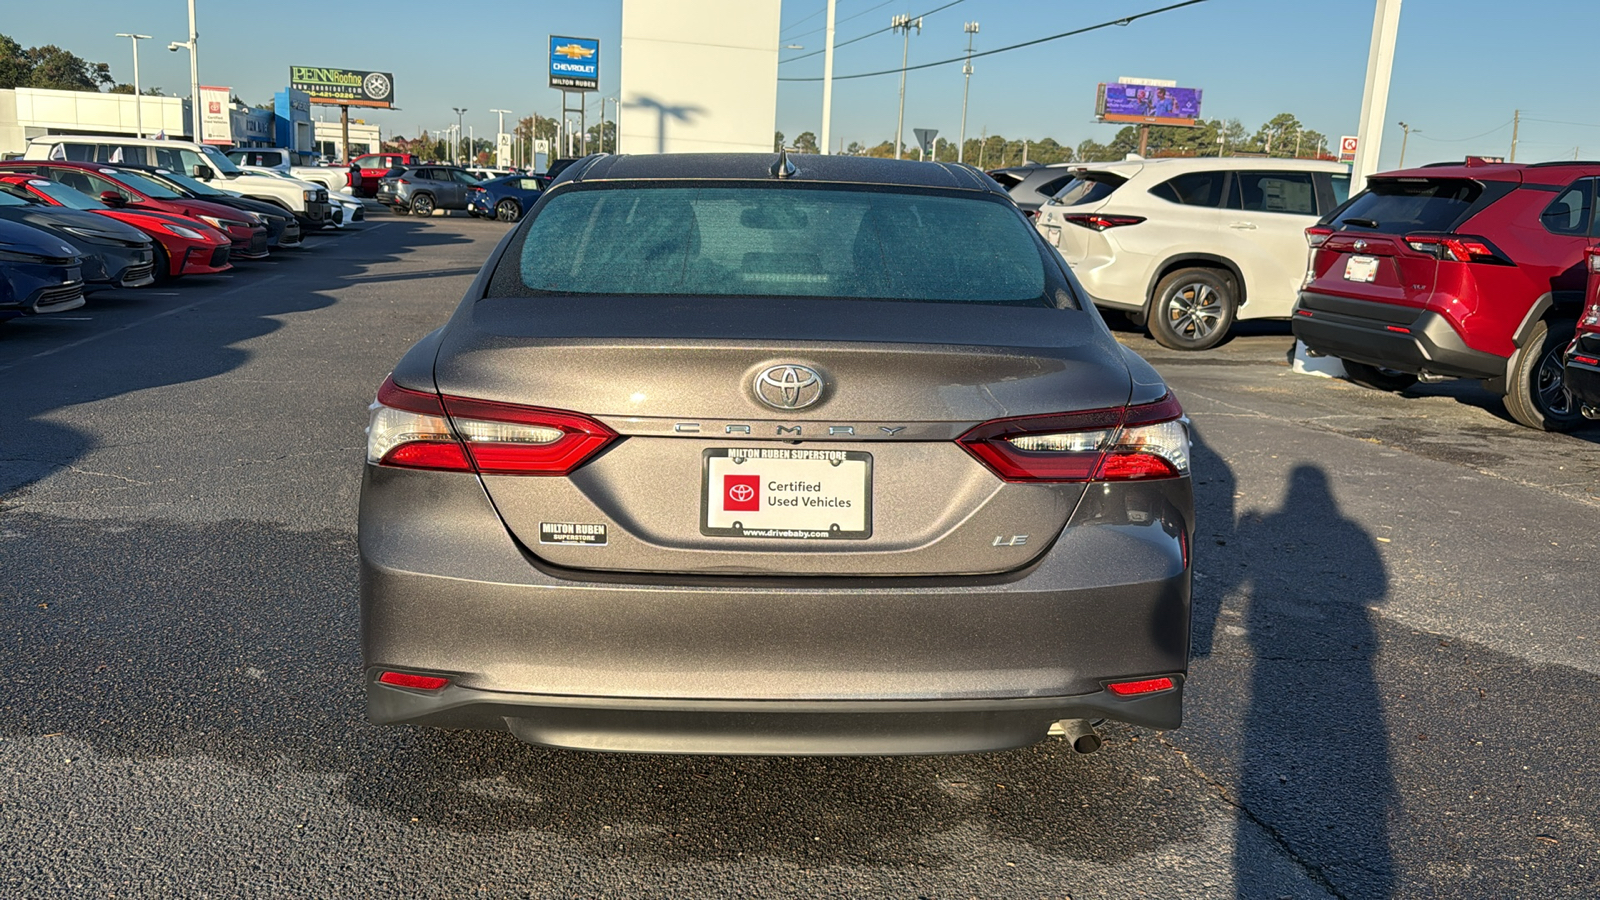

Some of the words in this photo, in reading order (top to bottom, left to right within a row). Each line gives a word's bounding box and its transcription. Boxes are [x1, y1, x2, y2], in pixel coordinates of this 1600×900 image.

[553, 63, 595, 73] CHEVROLET
[334, 71, 362, 87] Roofing
[552, 78, 574, 86] MILTON
[575, 80, 596, 88] RUBEN
[293, 83, 362, 94] www.pennroof.com
[674, 422, 908, 436] CAMRY
[728, 449, 759, 459] MILTON
[761, 449, 790, 459] RUBEN
[791, 450, 847, 461] SUPERSTORE
[768, 481, 821, 492] Certified
[768, 496, 798, 507] Used
[802, 497, 851, 508] Vehicles
[542, 523, 574, 533] MILTON
[575, 525, 605, 535] RUBEN
[743, 529, 829, 539] www.drivebaby.com
[992, 535, 1029, 547] LE
